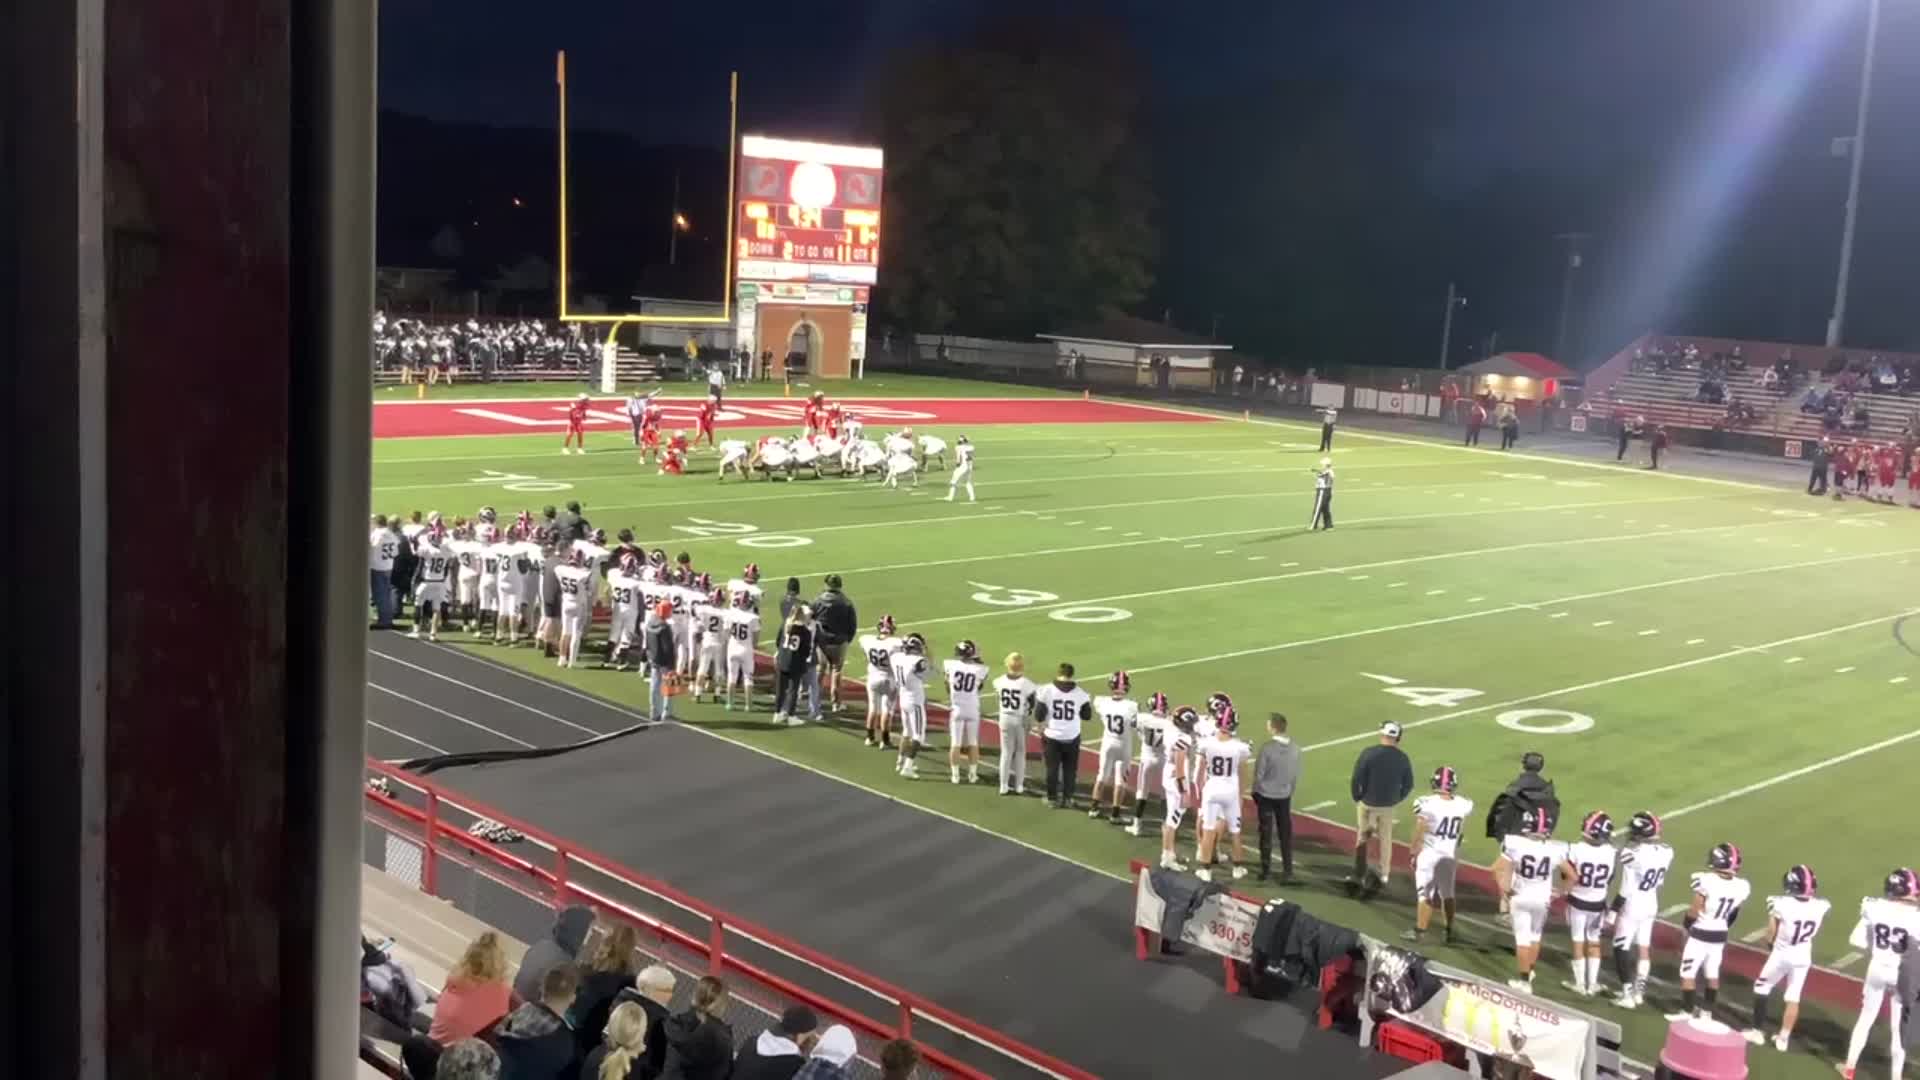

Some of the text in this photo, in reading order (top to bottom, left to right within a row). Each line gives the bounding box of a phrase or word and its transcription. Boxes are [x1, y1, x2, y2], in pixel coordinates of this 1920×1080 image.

[794, 244, 806, 258] TO
[807, 245, 819, 258] GO
[822, 247, 835, 259] ON
[430, 557, 445, 574] 18
[561, 577, 578, 595] 55
[614, 587, 631, 604] 33
[709, 616, 720, 633] 2
[730, 622, 749, 640] 46
[783, 634, 800, 651] 13
[869, 648, 889, 667] 62
[954, 671, 976, 692] 30
[1001, 688, 1021, 711] 65
[1053, 700, 1075, 721] 56
[1381, 687, 1596, 734] 40
[1106, 713, 1125, 735] 13
[1211, 755, 1233, 777] 81
[1435, 816, 1462, 841] 40
[1520, 855, 1550, 880] 64
[1580, 862, 1609, 889] 82
[1713, 898, 1735, 920] 11
[1791, 920, 1816, 946] 12
[1875, 923, 1909, 954] 83
